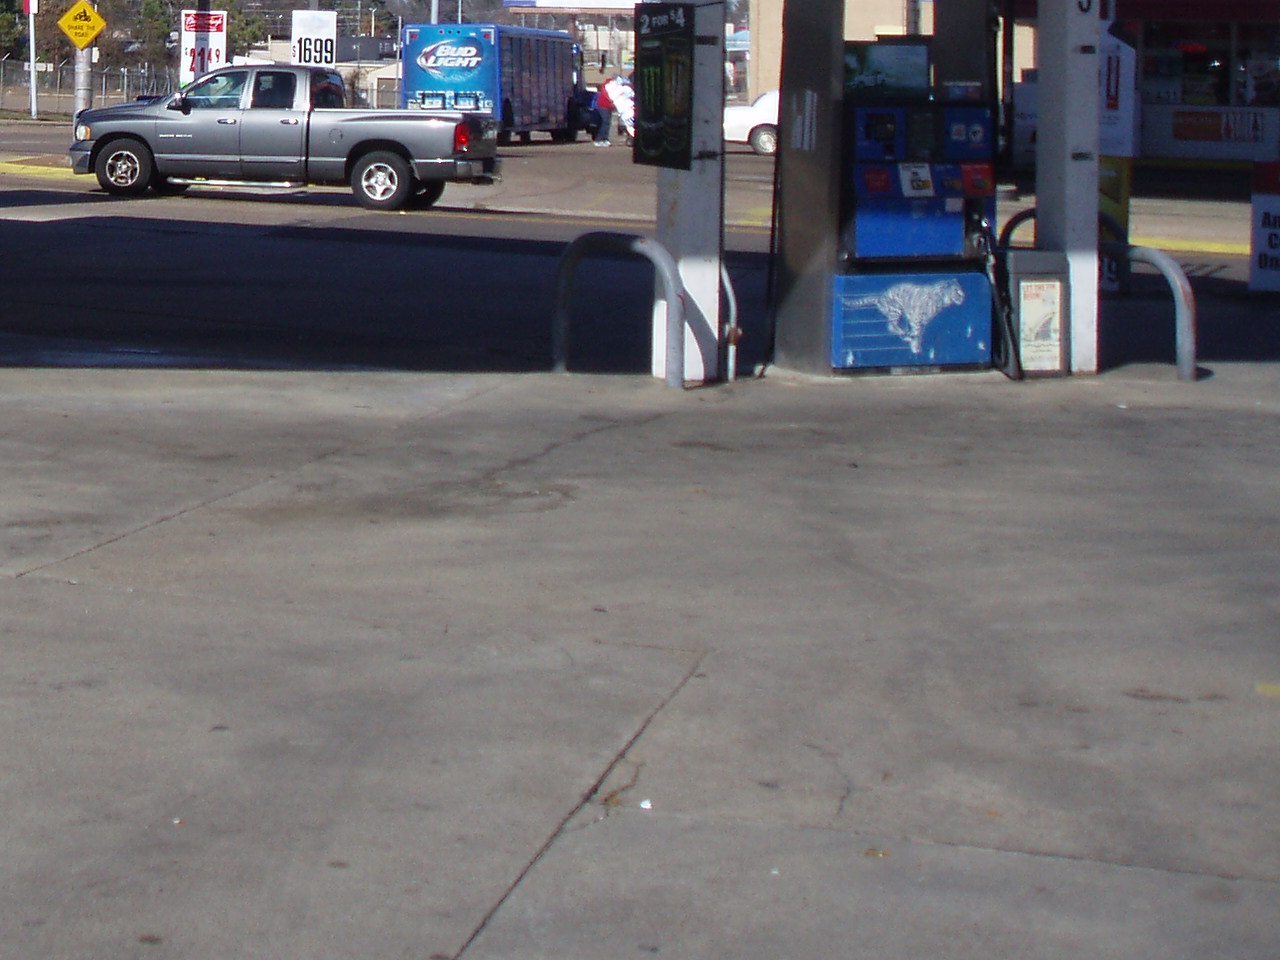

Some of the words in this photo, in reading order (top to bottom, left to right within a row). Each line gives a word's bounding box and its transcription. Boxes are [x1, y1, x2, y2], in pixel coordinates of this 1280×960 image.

[639, 14, 651, 34] 2
[652, 15, 669, 27] FOR
[436, 46, 477, 57] BUD
[426, 55, 482, 67] LIGHT
